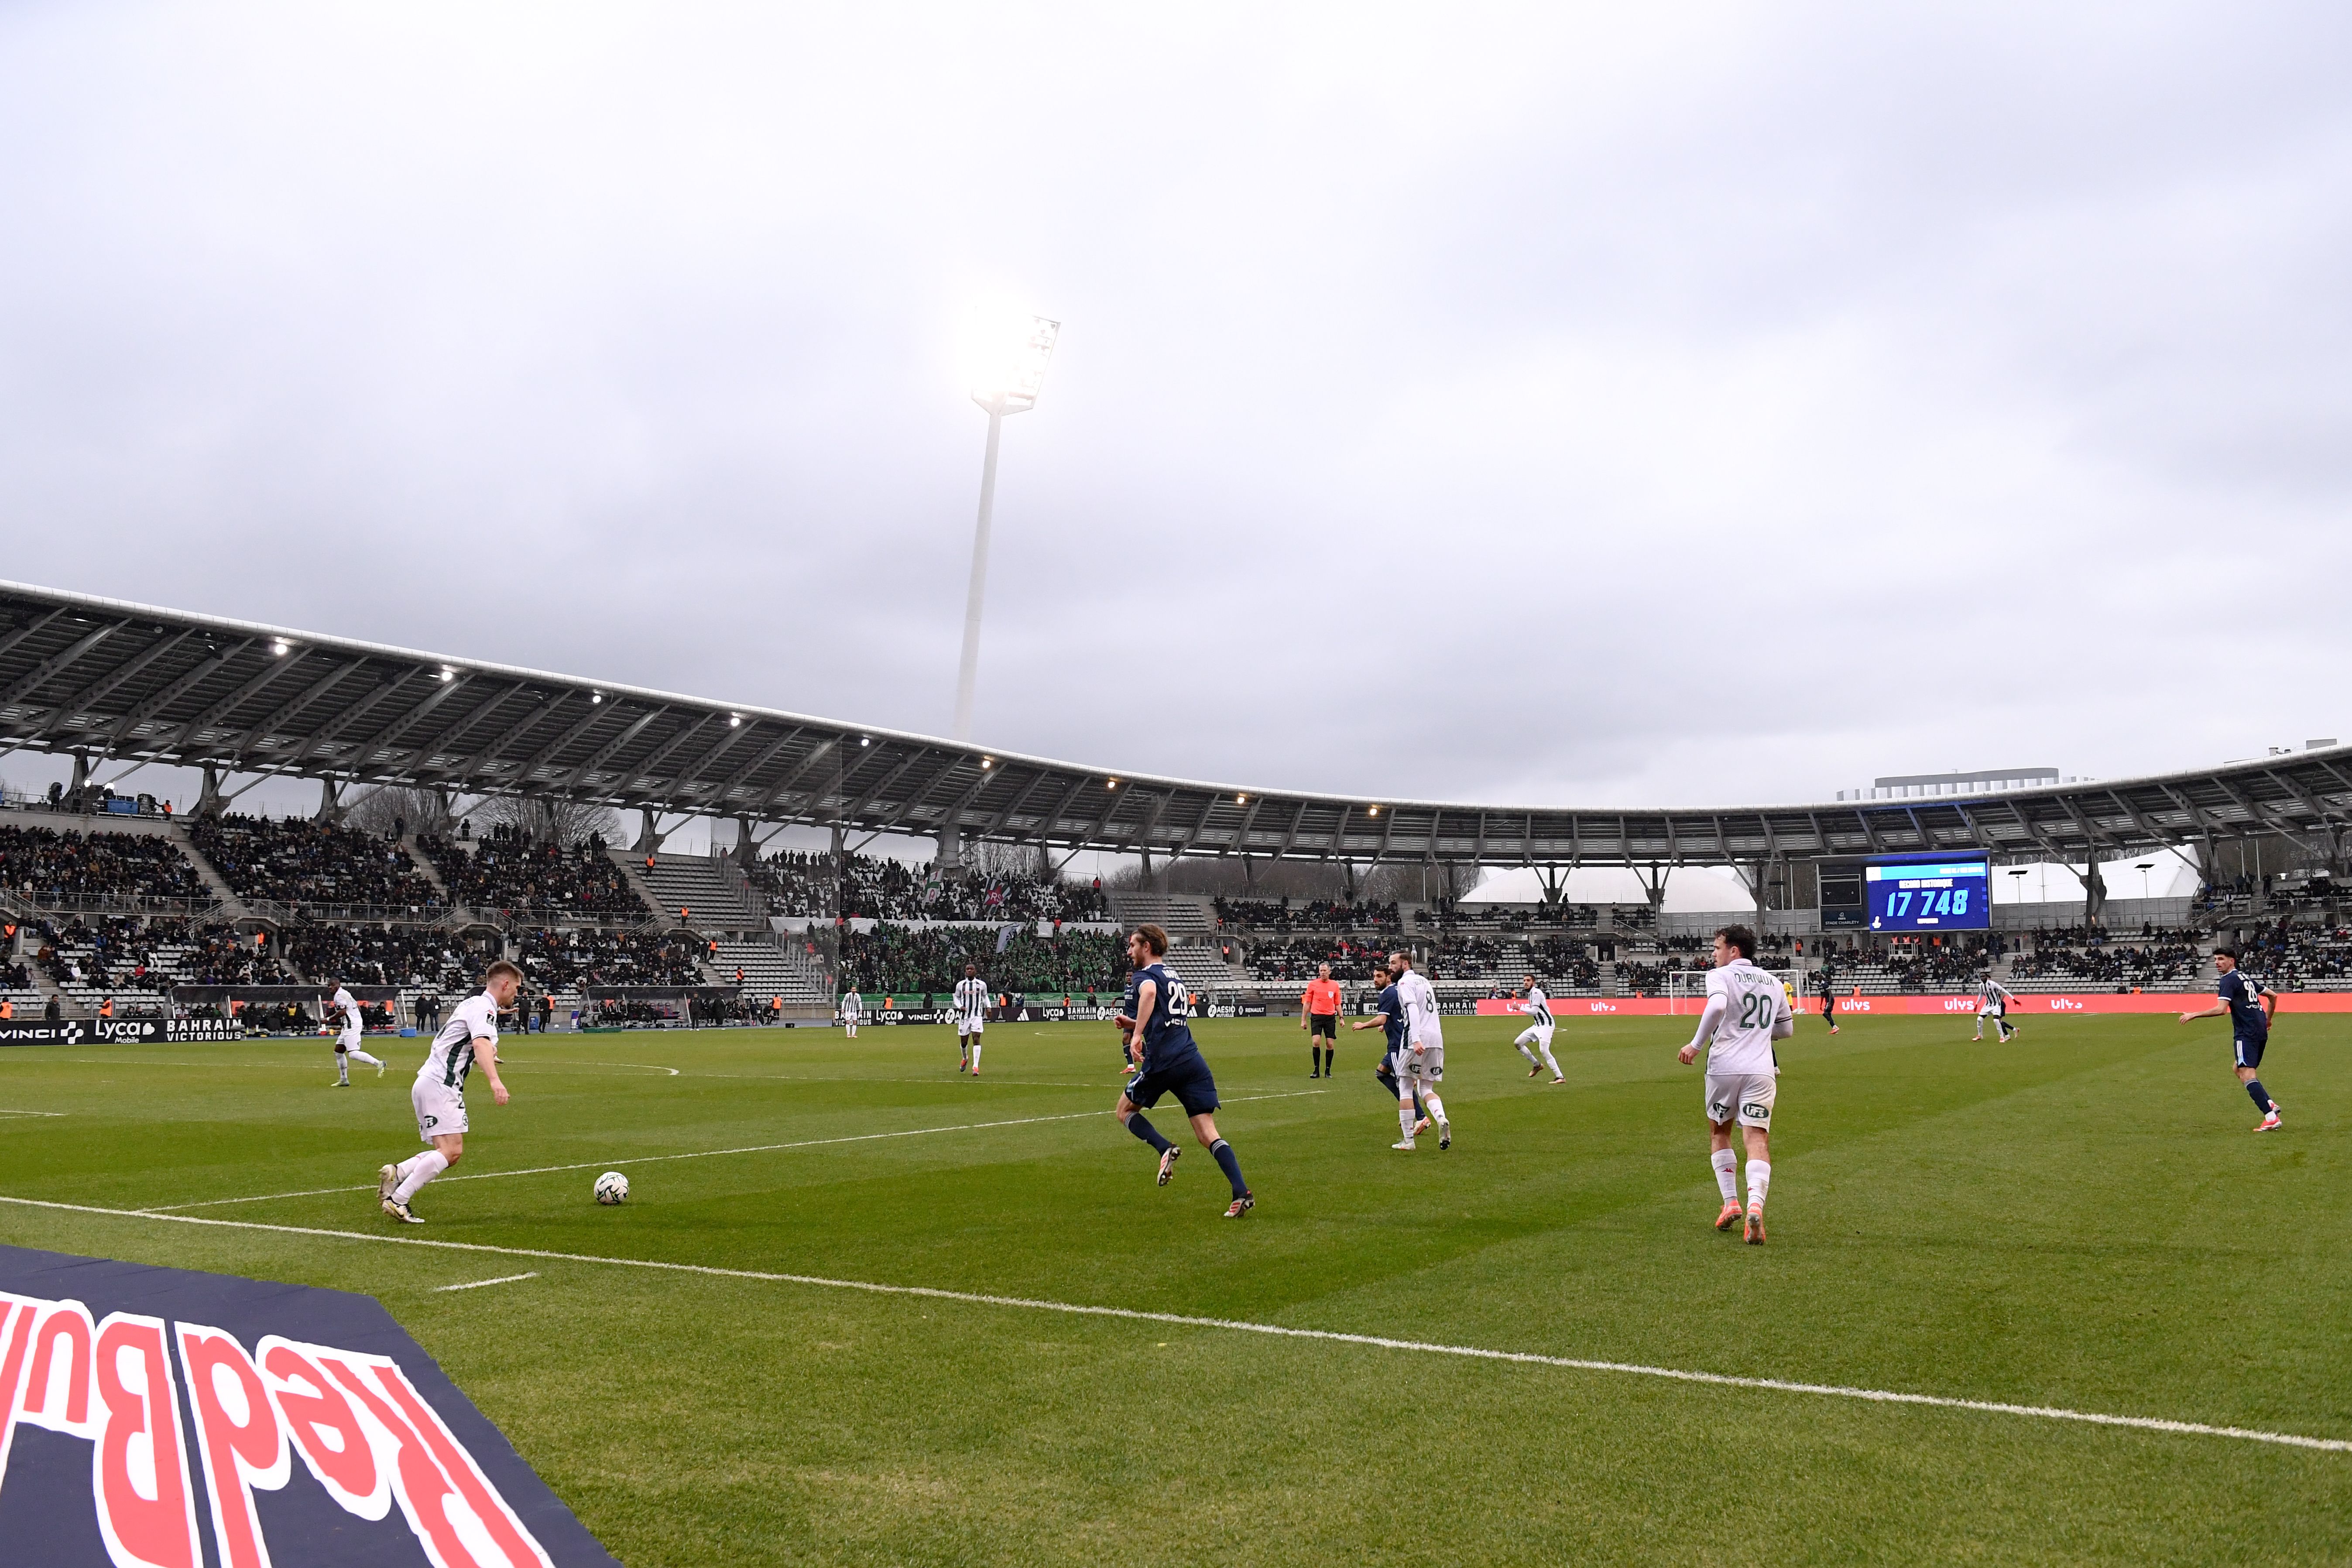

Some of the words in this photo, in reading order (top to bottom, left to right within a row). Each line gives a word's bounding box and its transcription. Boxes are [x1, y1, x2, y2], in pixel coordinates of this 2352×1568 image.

[1887, 891, 1912, 917] 17
[1920, 889, 1968, 916] 748
[1167, 981, 1188, 1016] 29
[1426, 991, 1434, 1013] 8
[1841, 998, 1870, 1011] ulys
[1944, 998, 1975, 1010] ulys
[835, 1010, 872, 1019] BAAIN
[876, 1009, 898, 1022] Lyca
[1042, 1007, 1059, 1019] Lyca
[1739, 992, 1772, 1029] 20
[95, 1019, 140, 1039] Lyca
[167, 1019, 242, 1032] BAHRAIN
[166, 1031, 241, 1042] VICTORIOUS
